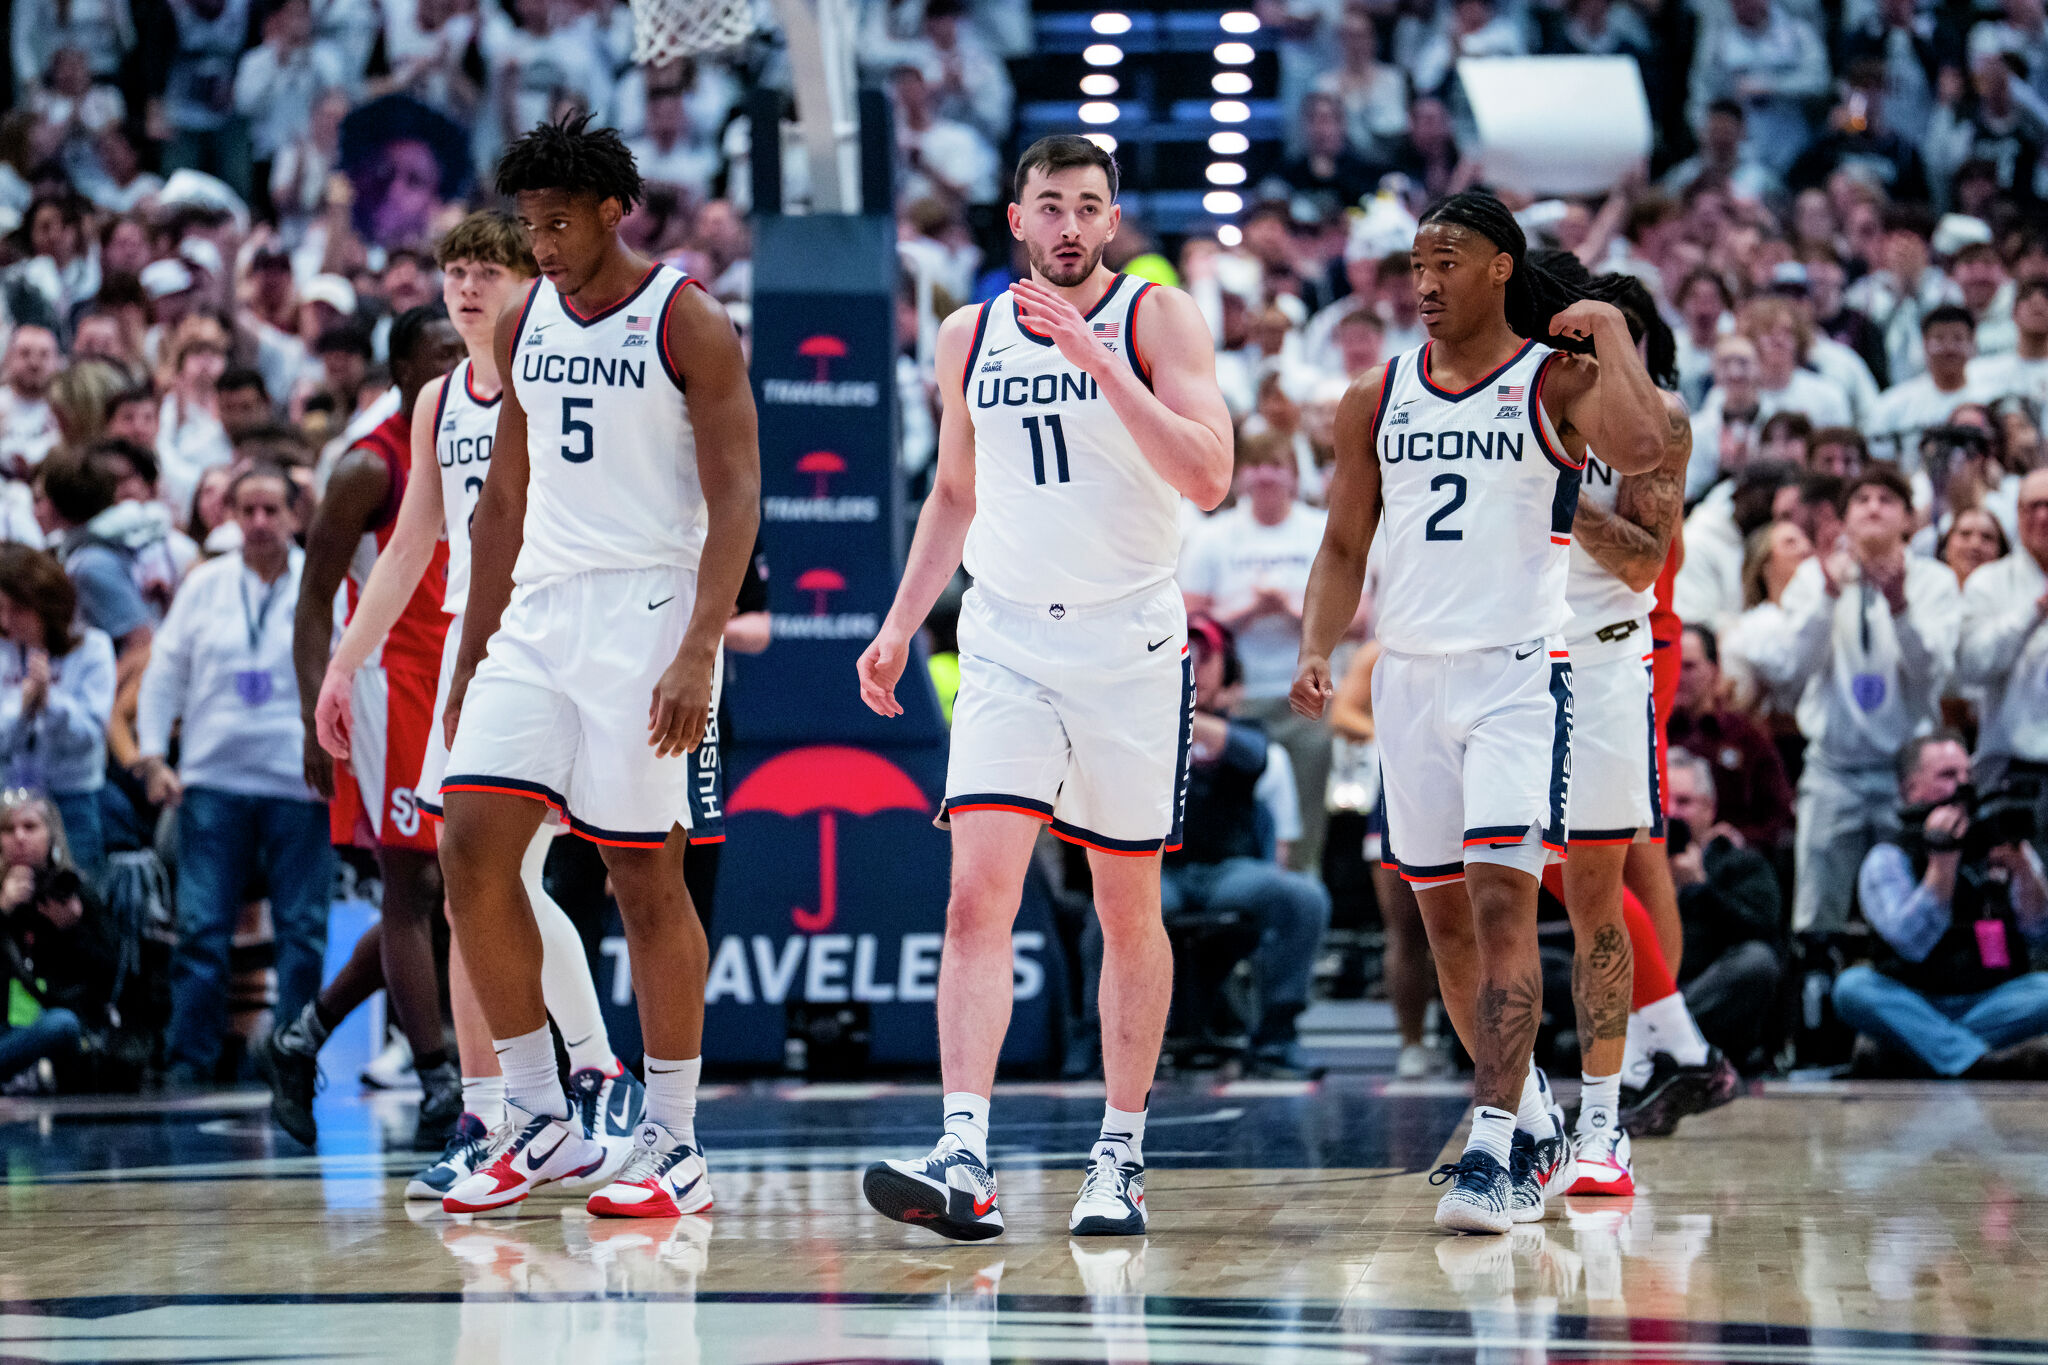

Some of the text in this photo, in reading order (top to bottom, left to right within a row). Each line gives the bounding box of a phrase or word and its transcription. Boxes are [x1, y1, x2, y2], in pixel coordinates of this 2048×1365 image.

[523, 354, 645, 389] UCONN
[762, 380, 878, 406] TRAVELERS
[440, 435, 493, 467] UCO
[561, 397, 594, 464] 5
[1021, 413, 1071, 486] 11
[1384, 430, 1524, 464] UCONN
[763, 496, 878, 521] TRAVELERS
[1425, 473, 1468, 541] 2
[698, 668, 722, 819] HUSKI
[599, 931, 1046, 1006] TAVELES
